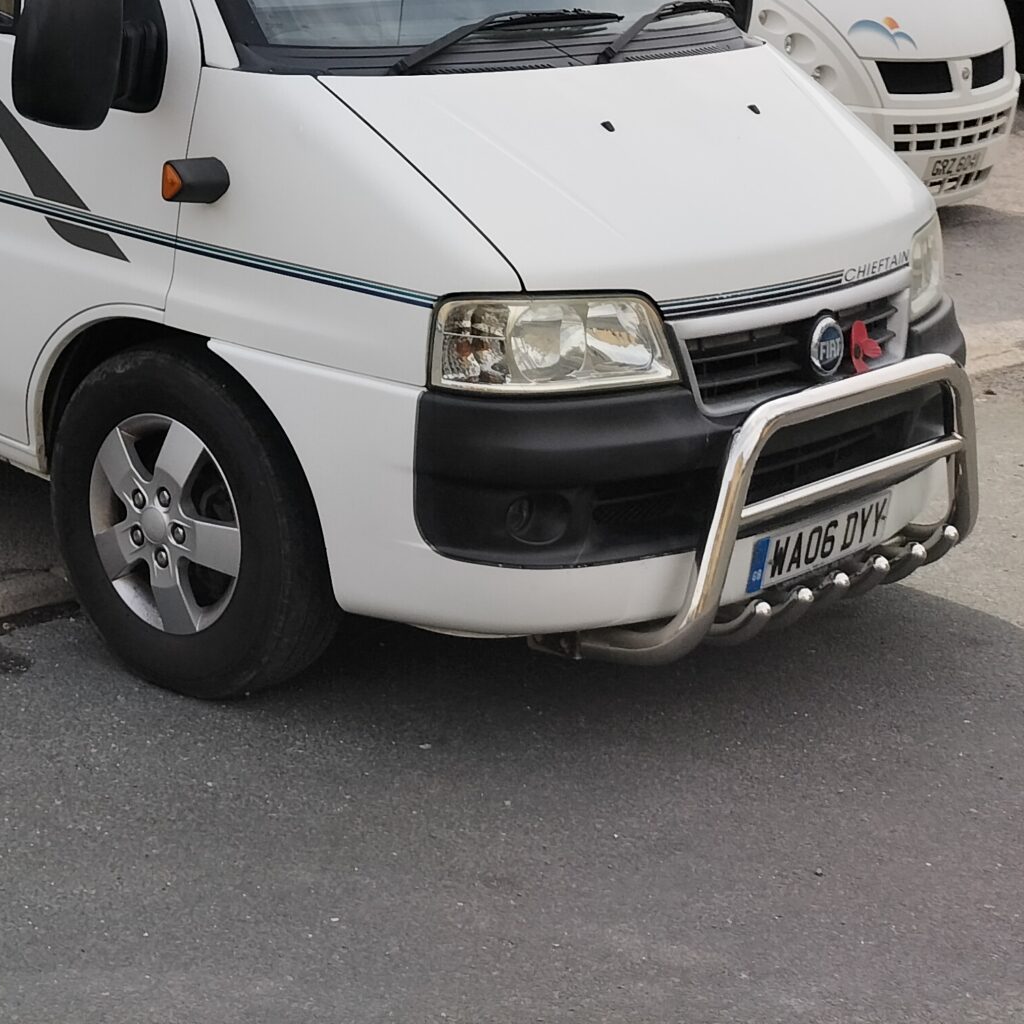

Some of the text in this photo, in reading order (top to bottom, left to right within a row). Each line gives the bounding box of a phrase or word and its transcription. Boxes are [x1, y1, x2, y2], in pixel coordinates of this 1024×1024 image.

[932, 158, 957, 176] GRZ
[844, 249, 910, 282] CHIEFTAIN
[819, 337, 842, 361] FIAT
[769, 498, 887, 578] WA06 DYY
